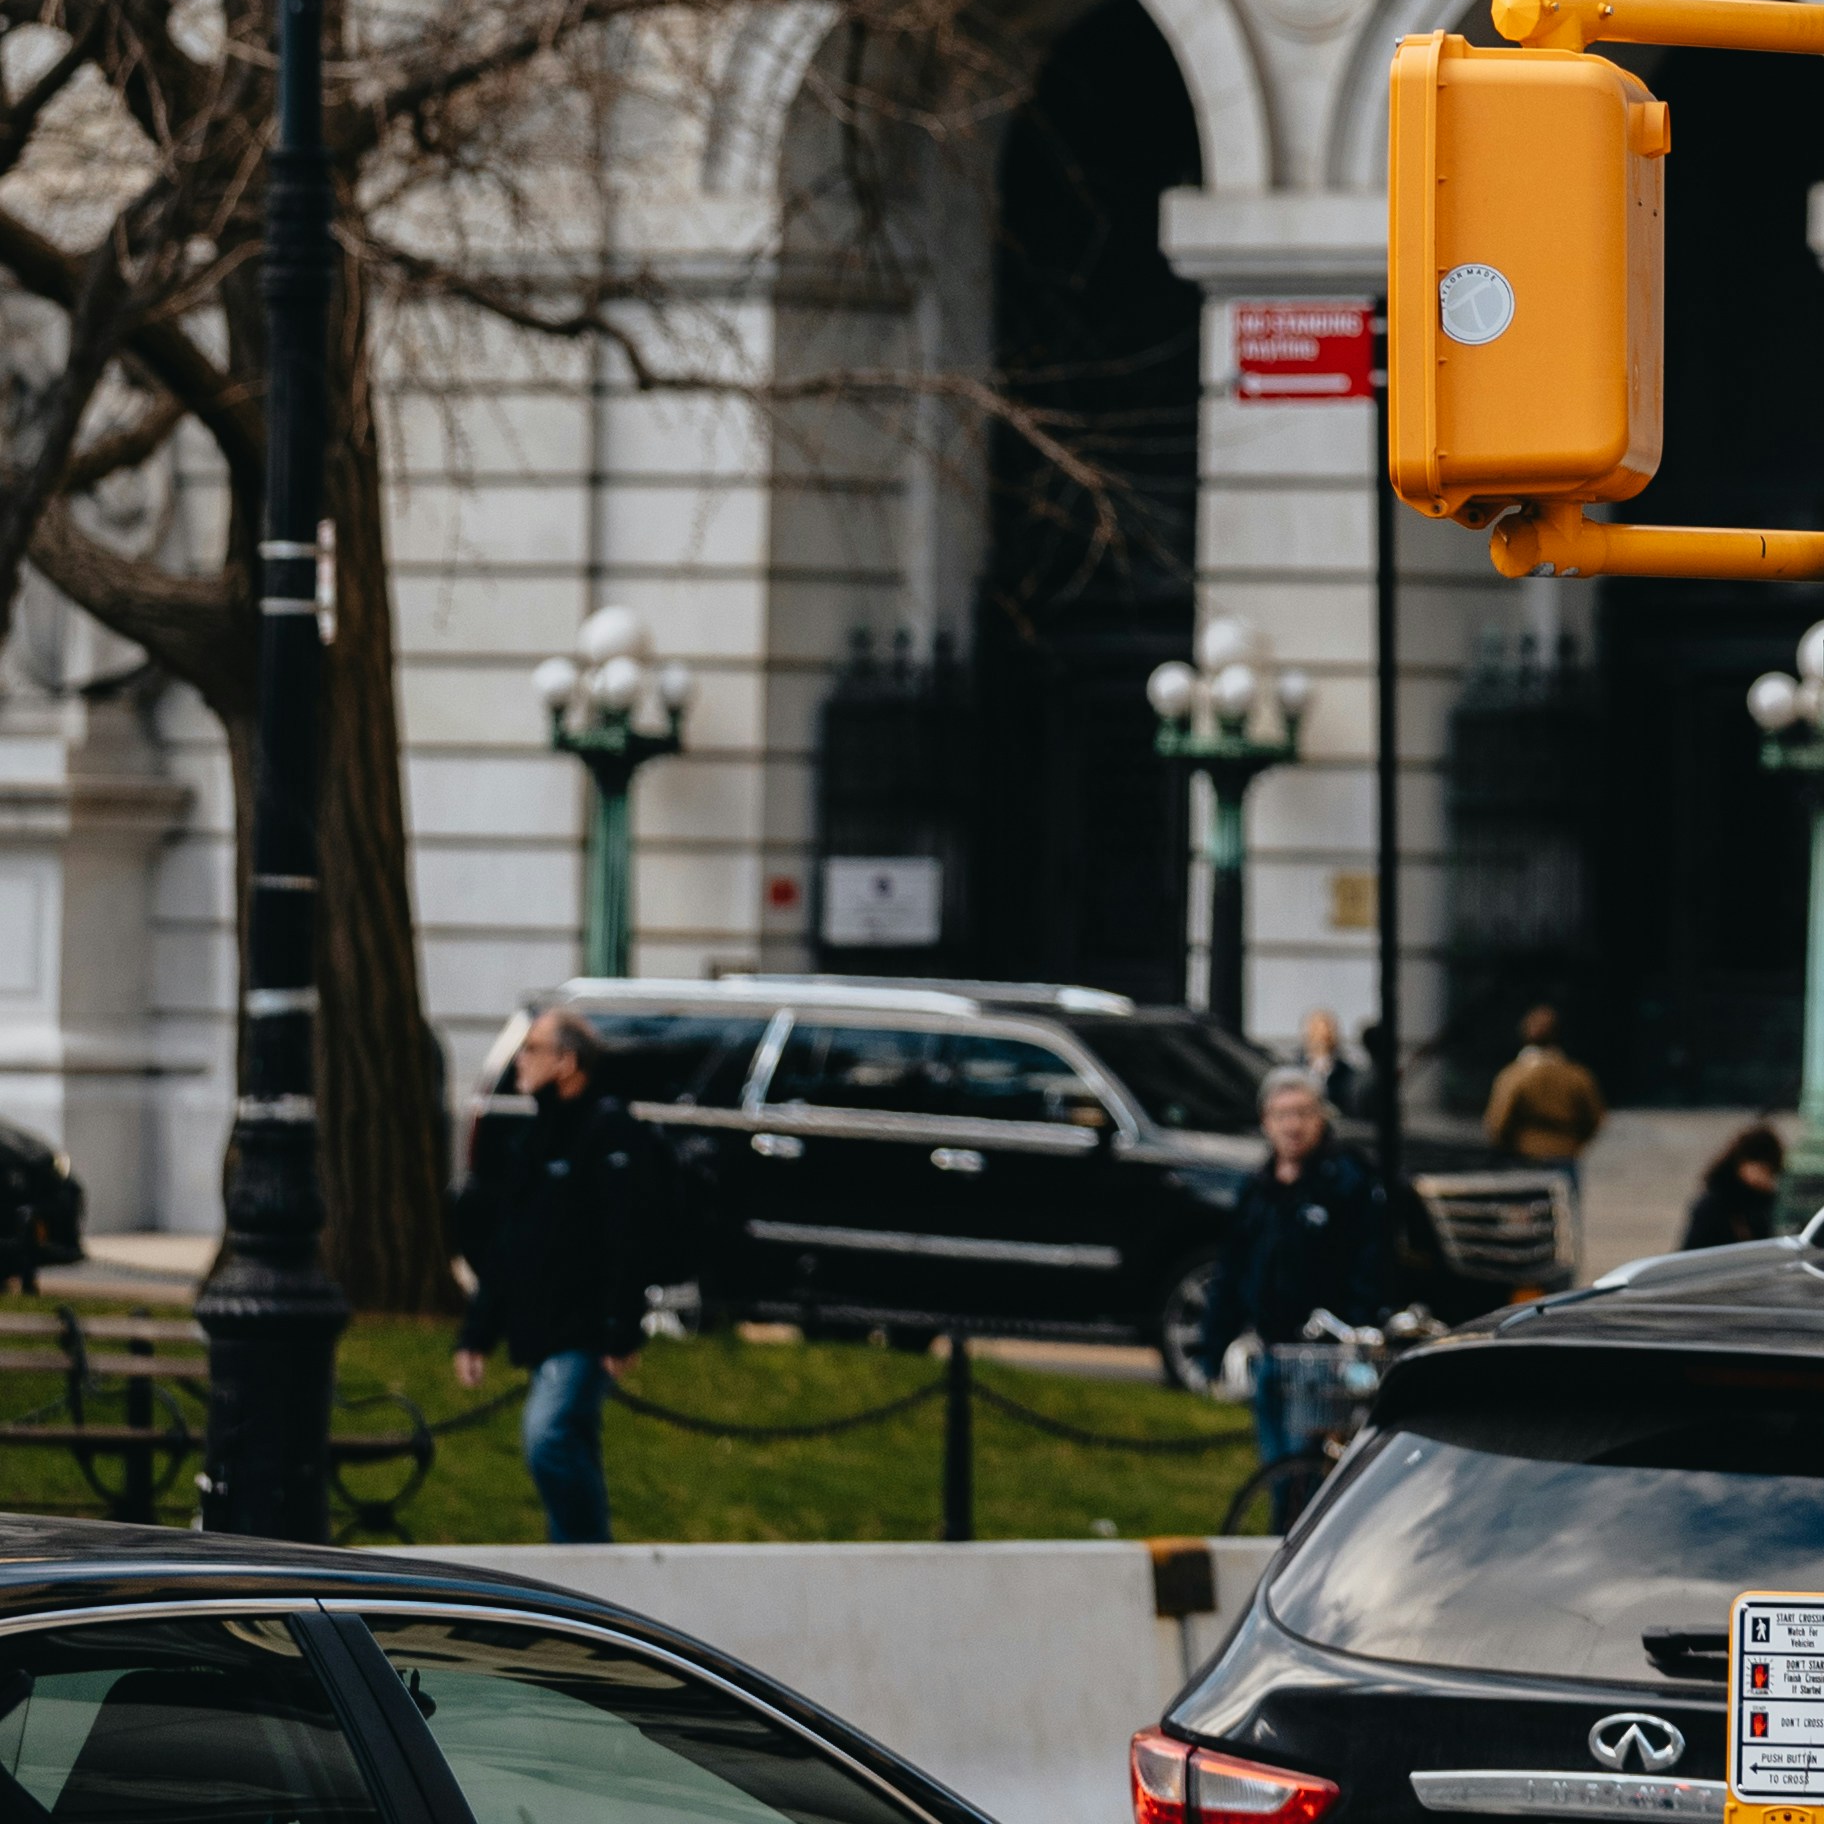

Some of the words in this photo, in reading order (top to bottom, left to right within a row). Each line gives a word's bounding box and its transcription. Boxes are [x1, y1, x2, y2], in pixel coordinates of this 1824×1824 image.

[1466, 268, 1496, 282] MADE
[1776, 1613, 1795, 1623] START
[1786, 1660, 1805, 1670] DON'T
[1781, 1718, 1800, 1728] DON'T
[1803, 1718, 1824, 1728] CROSS
[1761, 1753, 1783, 1763] PUSH
[1786, 1753, 1818, 1764] BUTTON
[1769, 1774, 1779, 1784] TO
[1782, 1774, 1810, 1785] CROSS
